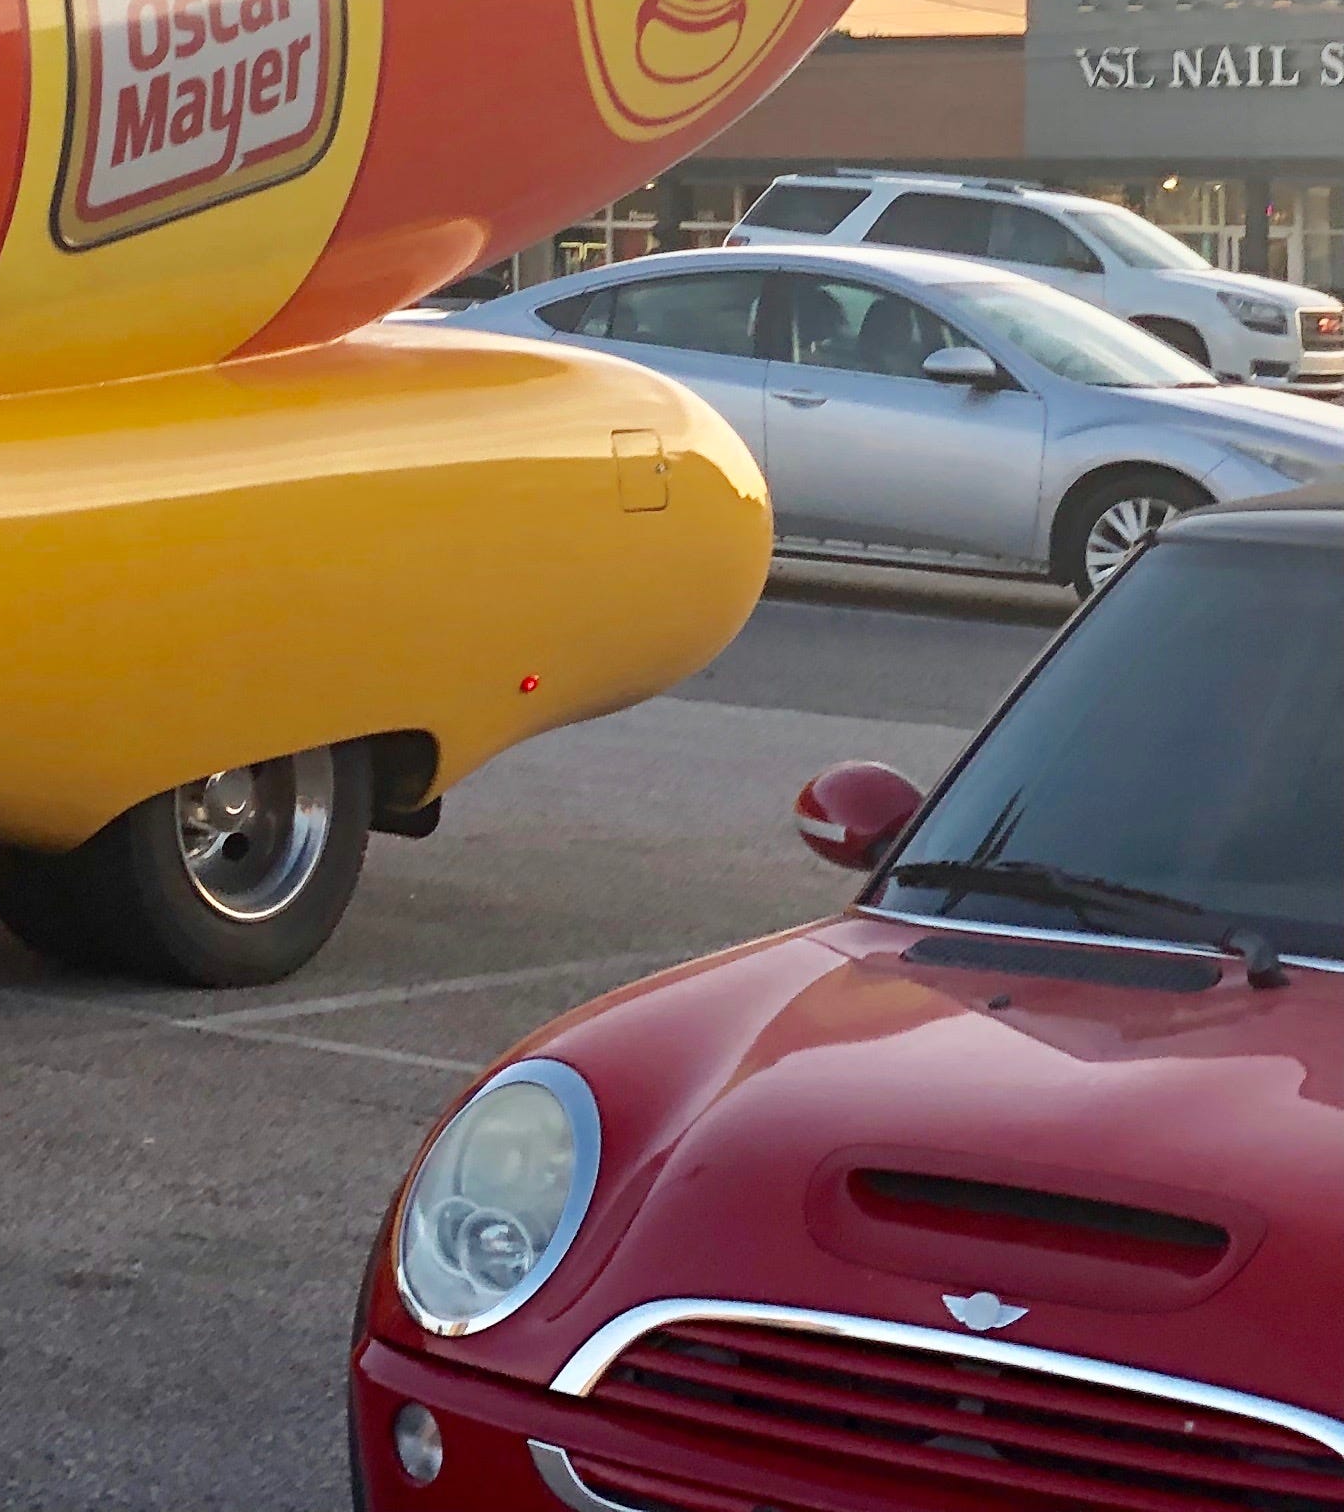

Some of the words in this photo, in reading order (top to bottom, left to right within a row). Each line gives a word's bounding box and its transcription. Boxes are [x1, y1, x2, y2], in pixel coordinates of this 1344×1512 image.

[111, 32, 312, 172] Mayer
[1073, 45, 1156, 89] VSL
[1168, 42, 1301, 89] NAIL
